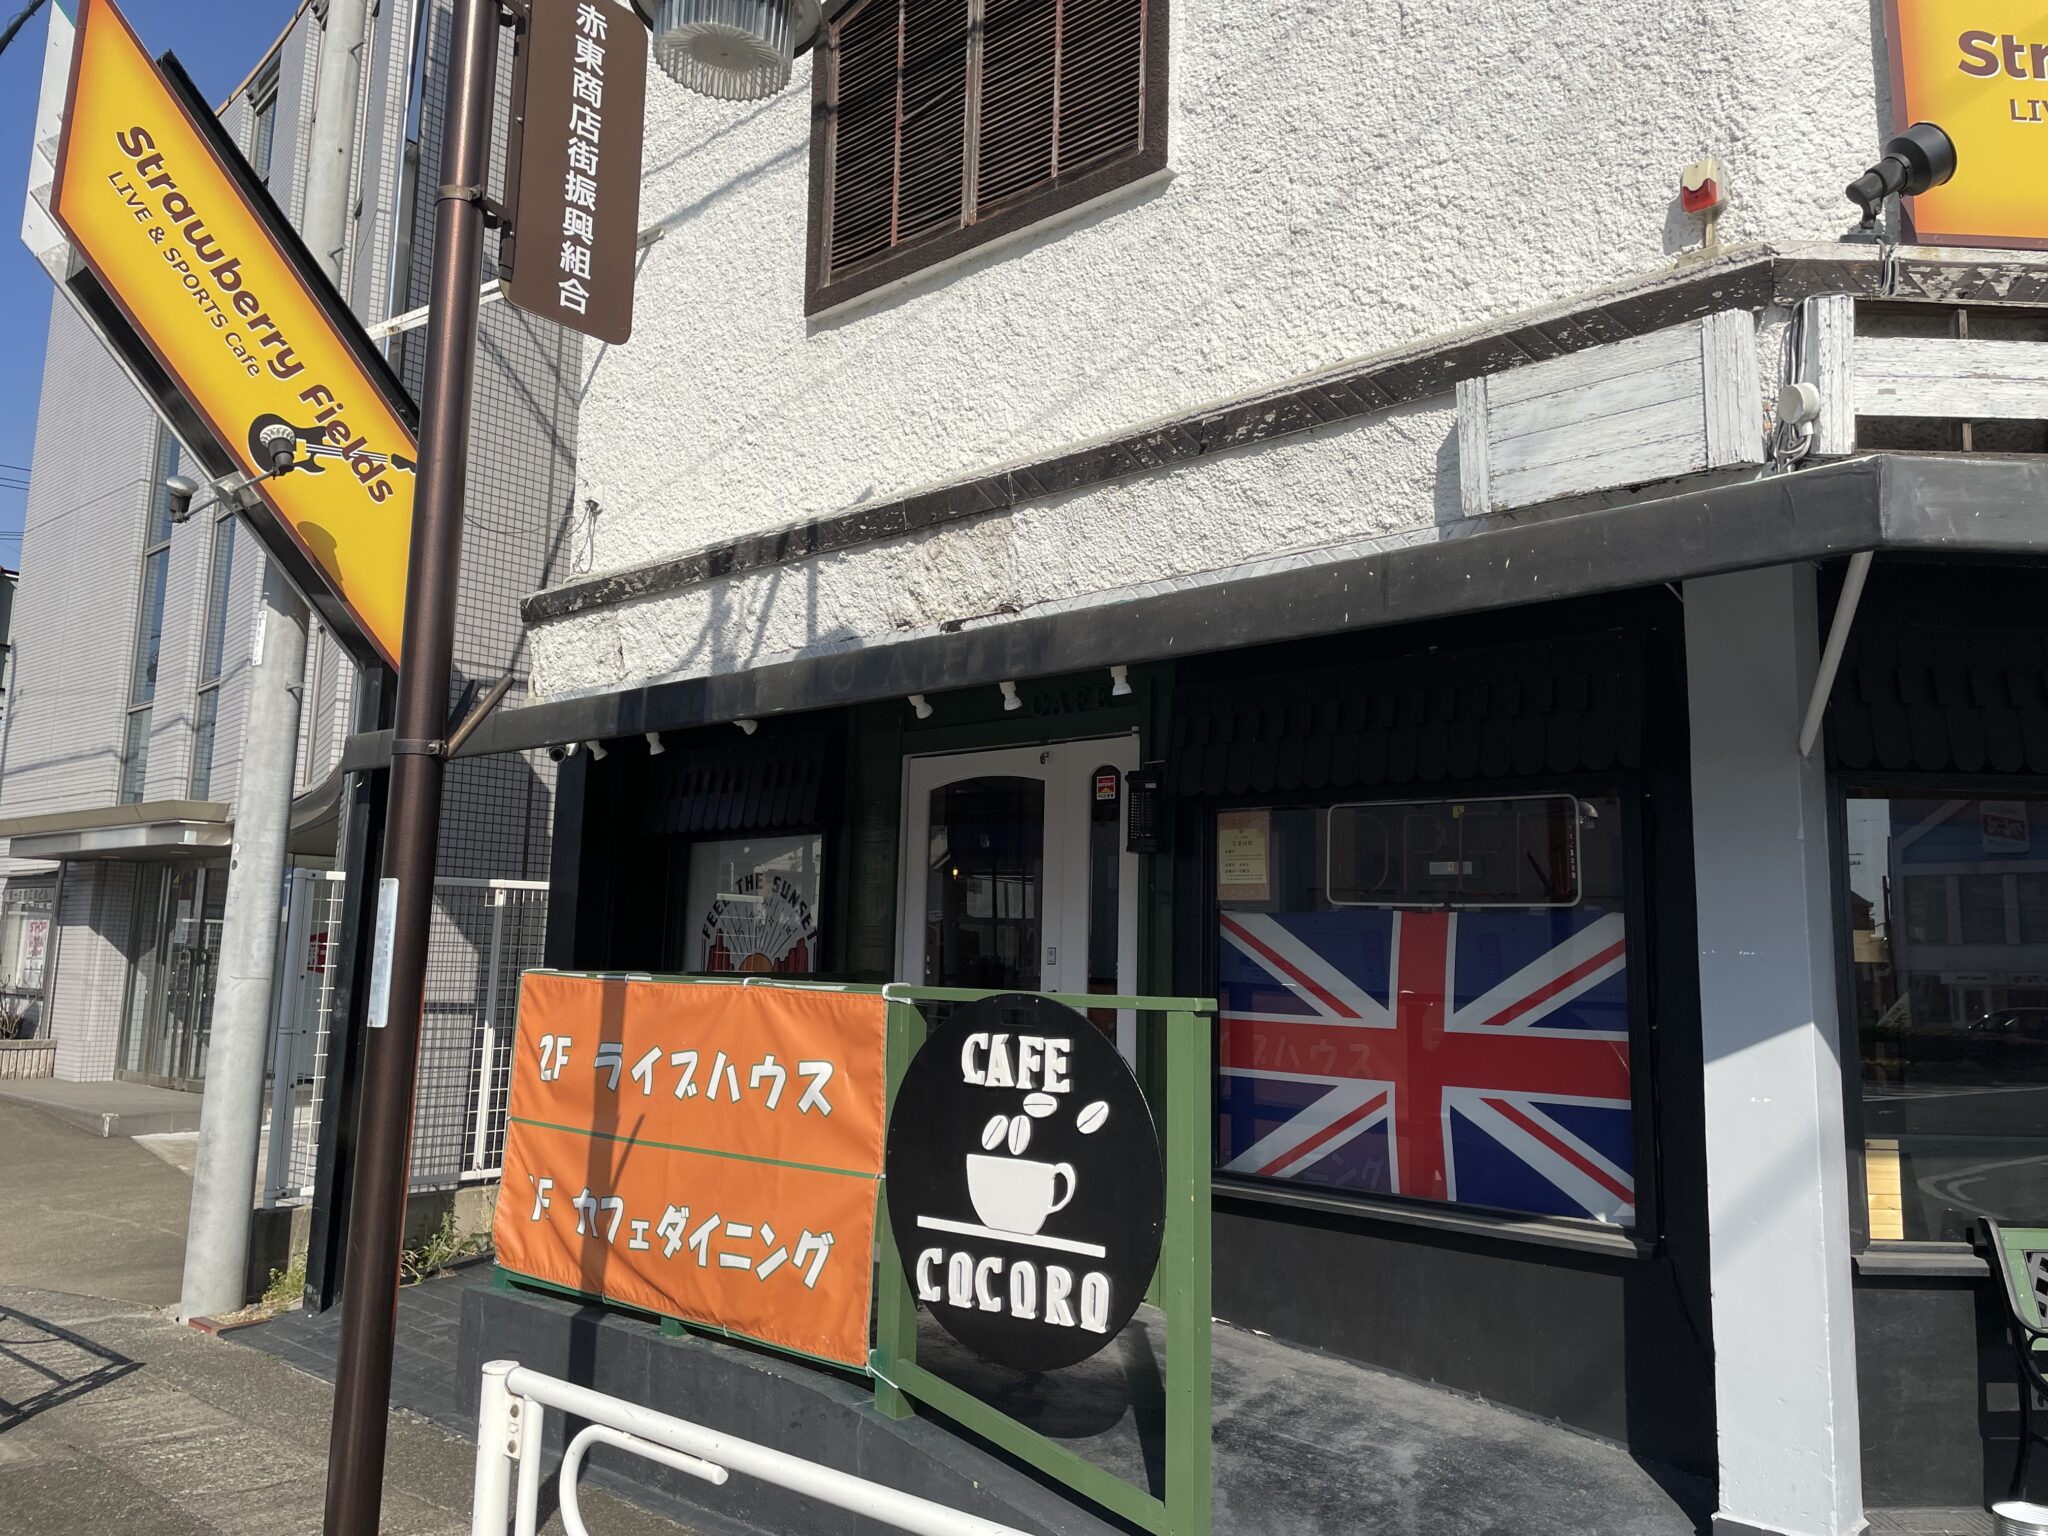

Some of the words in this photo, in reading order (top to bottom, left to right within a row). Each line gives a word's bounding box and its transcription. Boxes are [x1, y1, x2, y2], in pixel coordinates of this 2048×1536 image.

[558, 2, 608, 315] 赤東商店街振興組合
[107, 170, 154, 224] LIVE
[148, 226, 166, 246] &
[162, 247, 229, 330] SPORTS
[224, 331, 261, 378] Cafe
[115, 125, 306, 381] Strawberry
[298, 383, 394, 503] Fields
[735, 872, 764, 895] THE
[772, 876, 818, 941] SUNSET
[539, 1033, 572, 1082] 2F
[593, 1041, 835, 1118] ライブハウス
[961, 1032, 1071, 1093] CAFE
[528, 1173, 554, 1222] F
[572, 1186, 835, 1290] カフェダイニング
[916, 1247, 1111, 1335] COCORO
